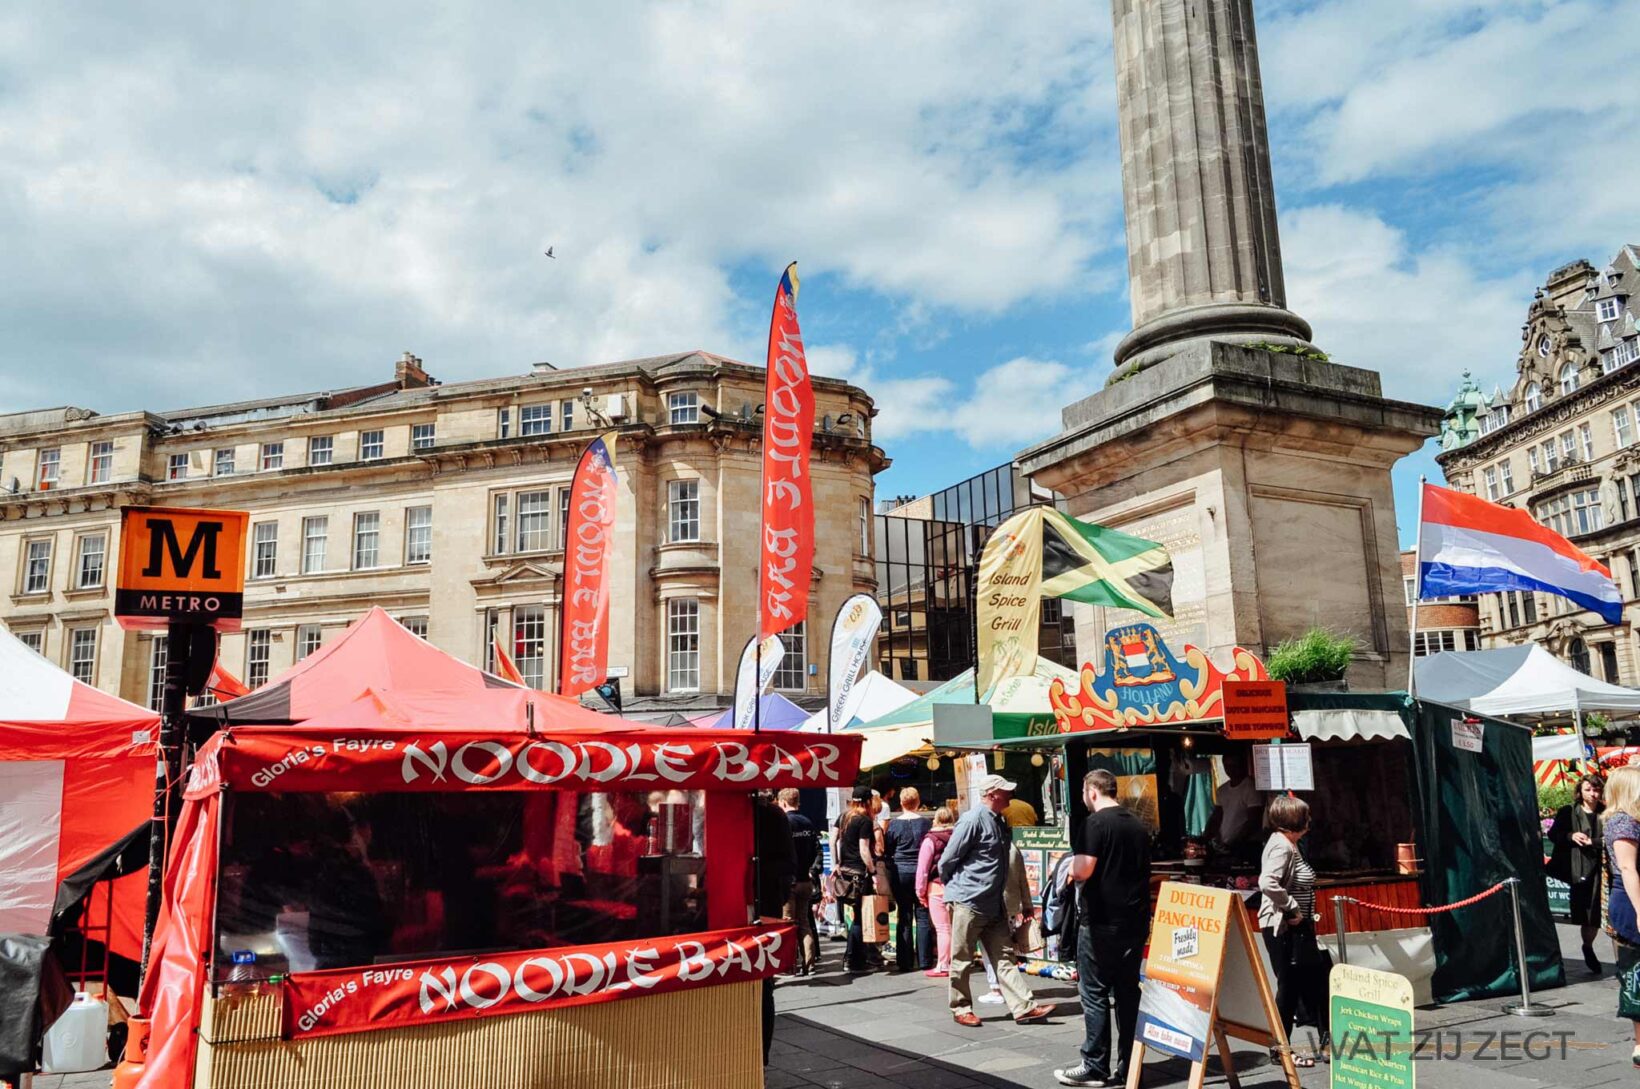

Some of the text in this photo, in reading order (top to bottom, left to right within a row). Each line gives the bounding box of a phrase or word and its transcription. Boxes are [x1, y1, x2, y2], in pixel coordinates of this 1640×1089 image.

[142, 518, 223, 579] M
[572, 478, 611, 609] NOODLE
[989, 571, 1032, 586] Island
[140, 595, 220, 612] METRO
[988, 593, 1027, 609] Spice
[991, 616, 1021, 632] Grill
[570, 618, 600, 685] BAR
[1120, 683, 1173, 704] HOLLAND
[1027, 717, 1059, 736] Isla
[250, 742, 327, 788] Gloria's
[333, 737, 396, 754] Fayre
[402, 739, 697, 784] NOODLE
[712, 741, 841, 782] BAR
[1170, 890, 1215, 909] DUTCH
[1157, 909, 1221, 934] PANCAKES
[1174, 928, 1196, 944] Freshly
[1177, 942, 1194, 956] made
[297, 931, 783, 1032] Gloria's Fayre NOODLE BAR
[1343, 968, 1398, 990] Island Spice
[1359, 986, 1380, 1000] Grill
[1340, 1006, 1402, 1027] Jerk Chicken Wraps
[1340, 1062, 1368, 1075] Jamaican
